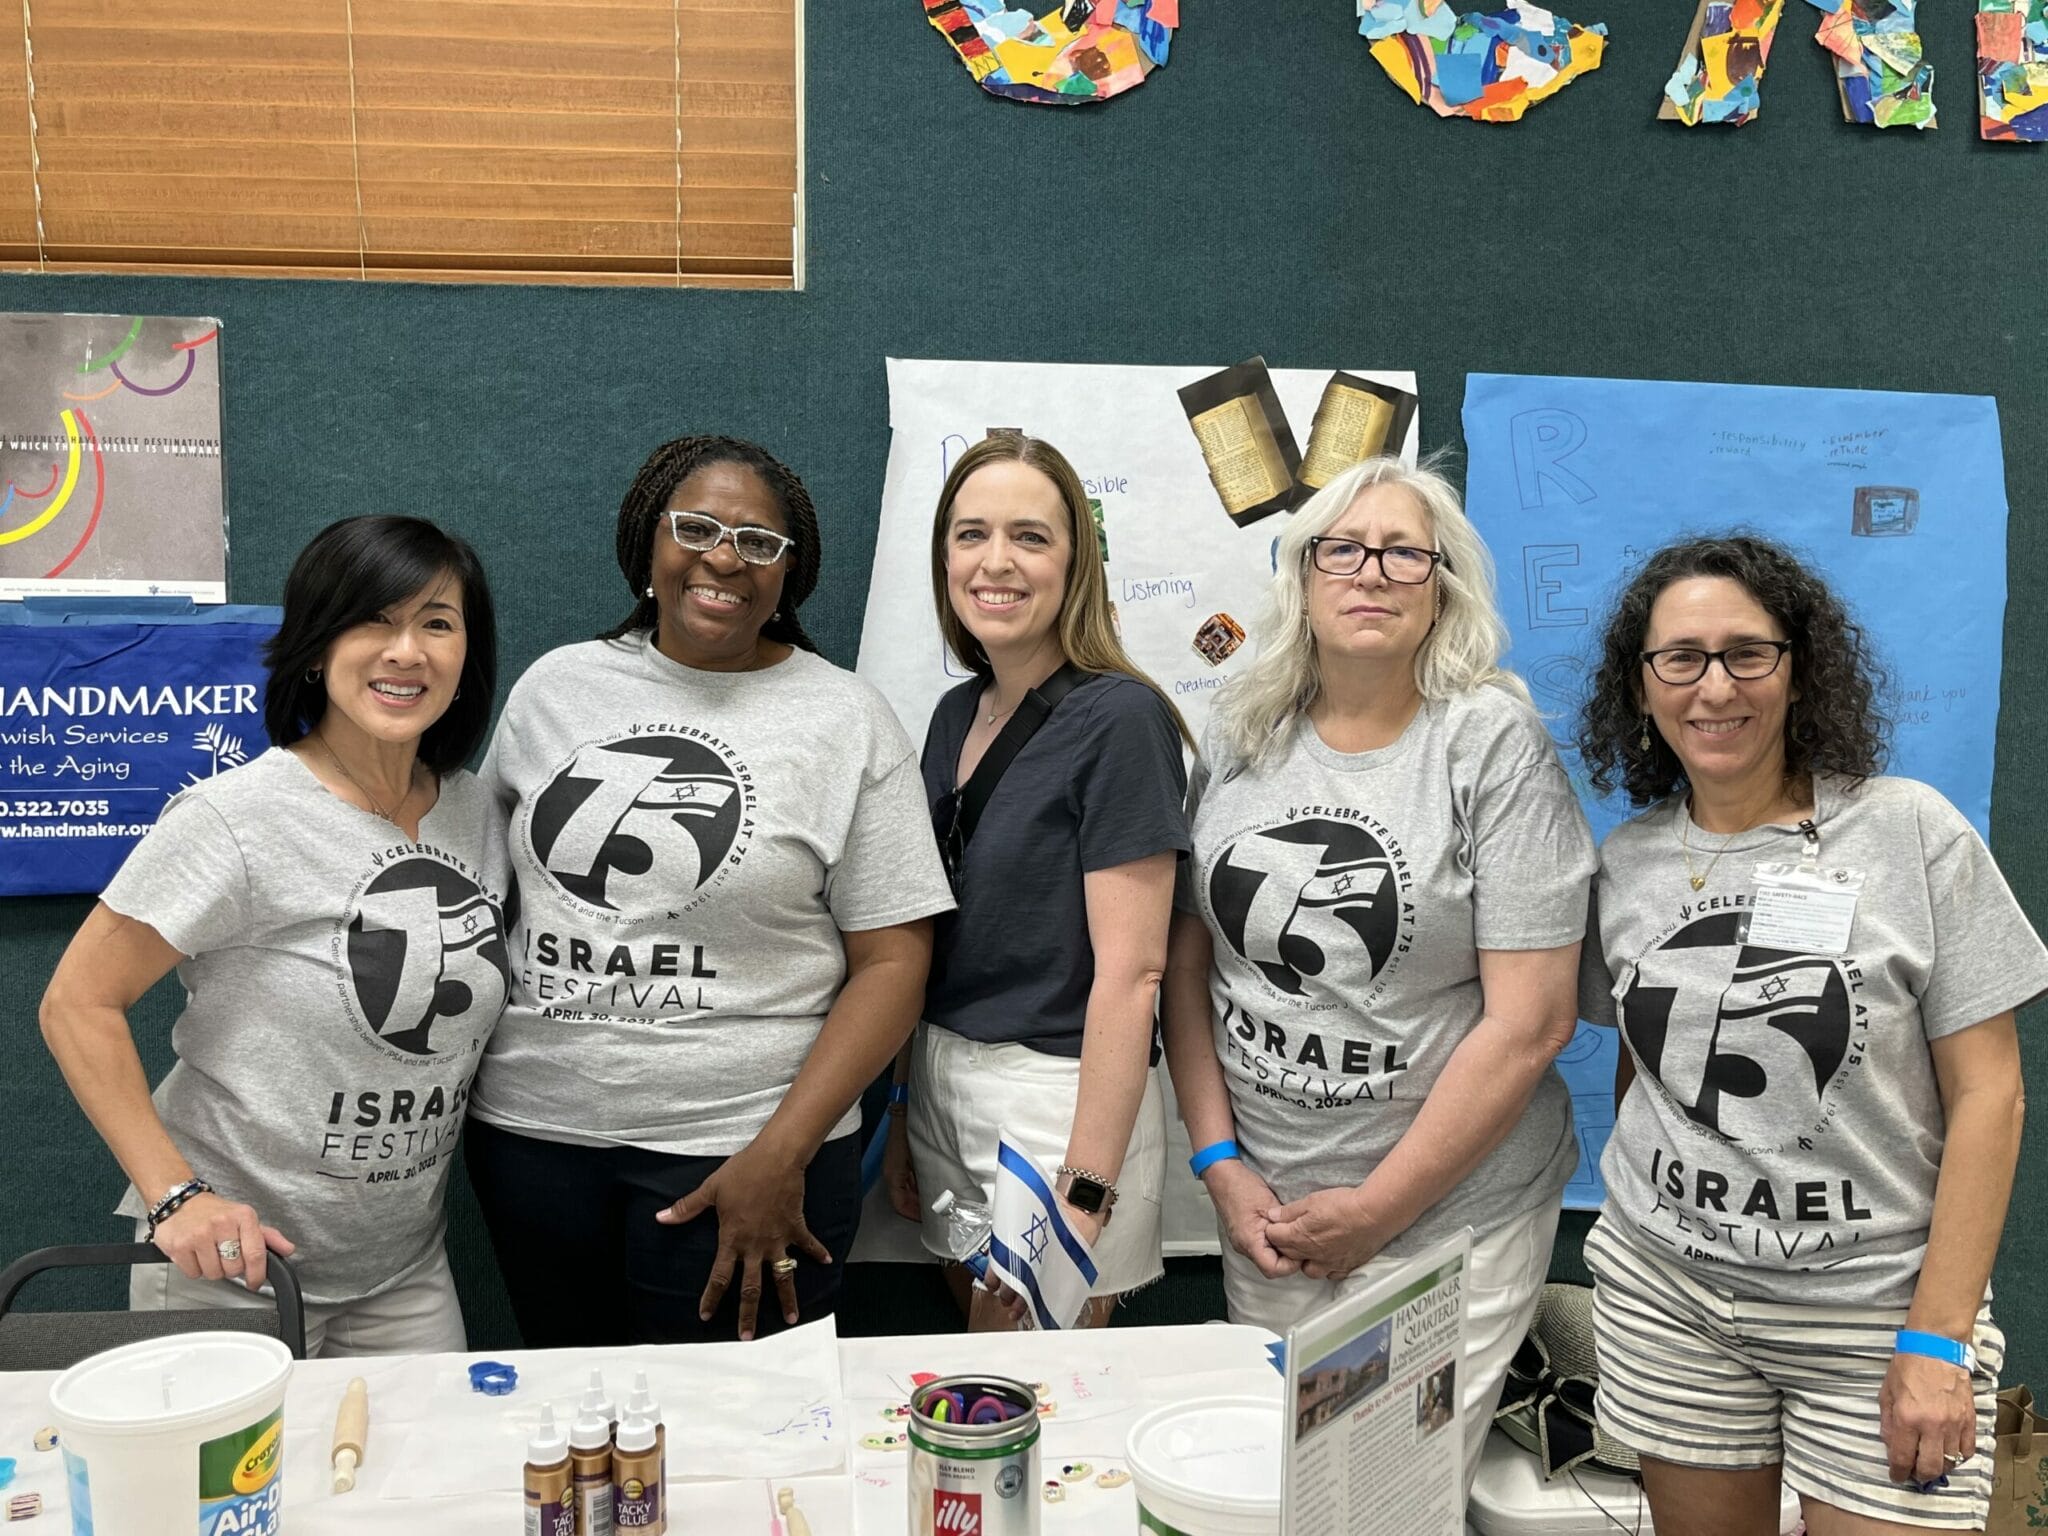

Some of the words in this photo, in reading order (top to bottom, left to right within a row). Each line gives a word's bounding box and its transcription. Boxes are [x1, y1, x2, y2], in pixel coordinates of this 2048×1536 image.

[10, 441, 49, 451] WHICH
[82, 442, 139, 453] TRAVELER
[163, 445, 219, 455] UNAWARE
[13, 434, 66, 444] JOURNEYS
[71, 435, 97, 444] HAVE
[102, 436, 139, 445] SECRET
[144, 437, 219, 447] DESTINATIONS
[1123, 573, 1196, 608] Listening
[1942, 687, 1966, 713] you
[63, 725, 169, 746] Services
[646, 723, 737, 759] CELEBRATE
[9, 754, 47, 777] the
[53, 755, 130, 781] Aging
[733, 760, 757, 812] ISRAEL
[742, 817, 756, 839] AT
[1302, 805, 1389, 836] CELEBRATE
[386, 843, 467, 873] CELEBRATE
[730, 846, 747, 866] 75
[1385, 836, 1413, 893] ISRAEL
[560, 893, 578, 910] JPSA
[578, 905, 595, 918] and
[595, 912, 611, 922] the
[614, 915, 645, 926] Tucson
[684, 891, 711, 913] 1948
[1402, 902, 1415, 926] AT
[524, 928, 718, 979] ISRAEL
[1398, 934, 1414, 954] 75
[522, 969, 714, 1011] FESTIVAL
[1363, 981, 1387, 1008] 1948
[336, 983, 362, 1033] partnership
[541, 1006, 585, 1022] APRIL
[1305, 1002, 1338, 1012] Tucson
[1855, 1003, 1869, 1030] AT
[1222, 997, 1408, 1075] ISRAEL
[1848, 1042, 1866, 1066] 75
[1660, 1091, 1688, 1127] between
[1686, 1121, 1708, 1139] JPSA
[1708, 1133, 1728, 1146] and
[1814, 1102, 1837, 1134] 1948
[321, 1117, 459, 1161] FESTIVA
[366, 1170, 401, 1184] APRIL
[1651, 1148, 1872, 1221] ISRAEL
[1650, 1191, 1860, 1260] FESTIVA
[1395, 1276, 1461, 1329] HANDMAKER
[1404, 1295, 1462, 1346] QUARTERLY
[953, 1465, 975, 1474] BLEND
[617, 1502, 652, 1516] TACKY
[619, 1514, 649, 1526] GLUE
[936, 1499, 979, 1536] illy
